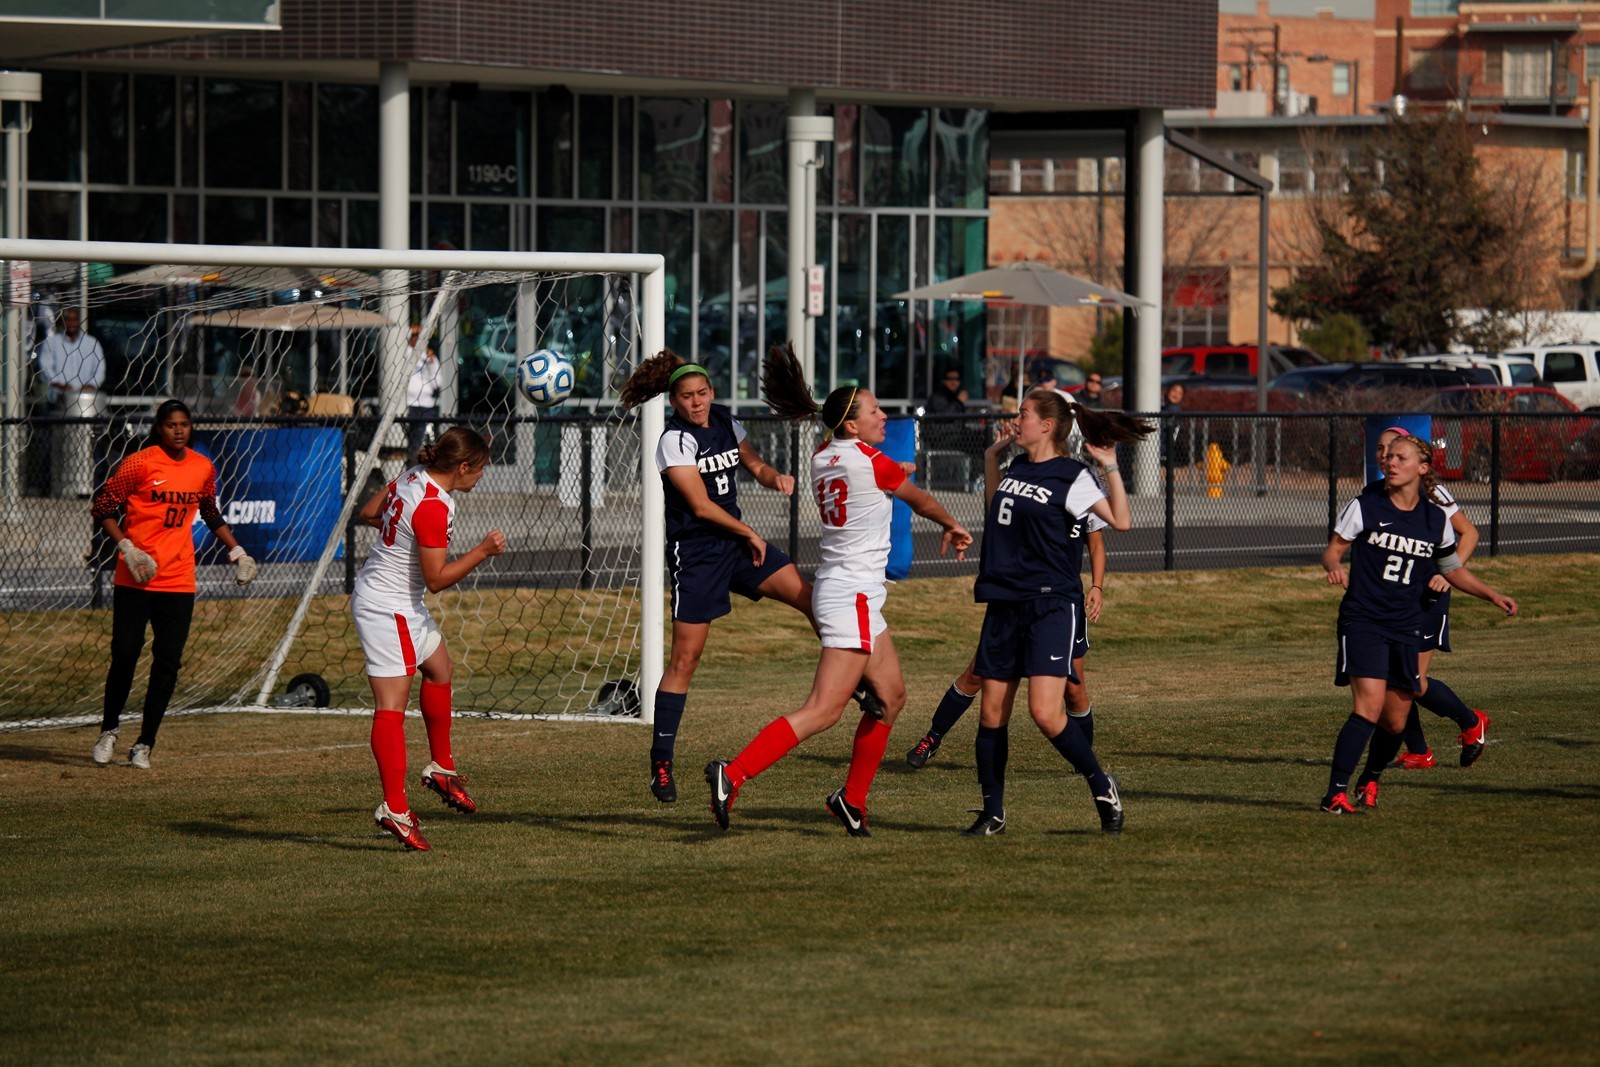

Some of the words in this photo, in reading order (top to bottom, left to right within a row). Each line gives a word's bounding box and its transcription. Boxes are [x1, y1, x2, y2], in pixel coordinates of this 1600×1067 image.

[468, 164, 517, 184] 1190-C
[150, 489, 203, 505] MINES
[715, 471, 729, 496] 8
[817, 478, 848, 528] 13
[997, 496, 1015, 526] 6
[1367, 531, 1435, 558] MINES
[1382, 554, 1415, 585] 21
